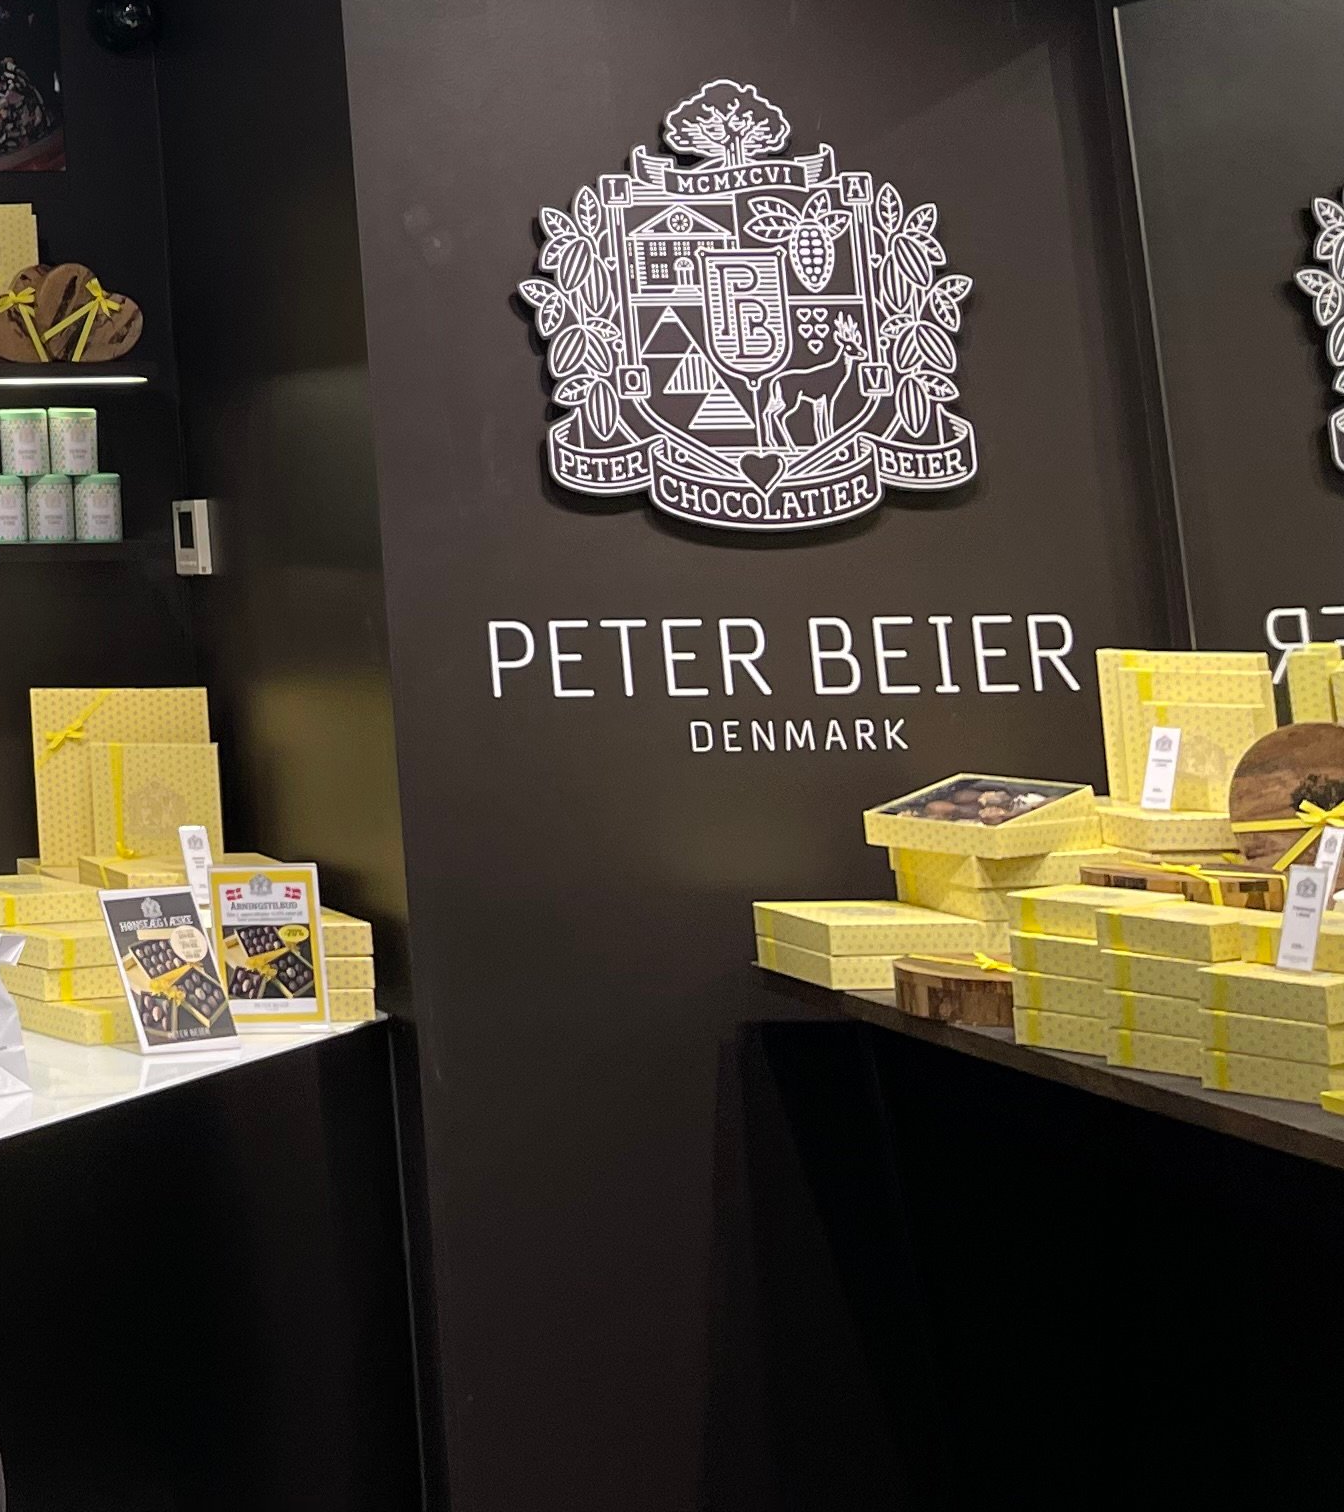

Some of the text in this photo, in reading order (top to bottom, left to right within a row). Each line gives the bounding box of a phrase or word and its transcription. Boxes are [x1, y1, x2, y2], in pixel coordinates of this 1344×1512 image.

[608, 178, 624, 202] L
[677, 167, 793, 194] MCMXCVI
[846, 175, 866, 199] A
[627, 368, 641, 392] O
[865, 368, 885, 393] V
[559, 452, 647, 480] PETER
[880, 448, 968, 476] BEIER
[659, 476, 874, 520] CHOCOLATIER
[488, 612, 1082, 699] PETER BEIER
[690, 718, 910, 753] DENMARK
